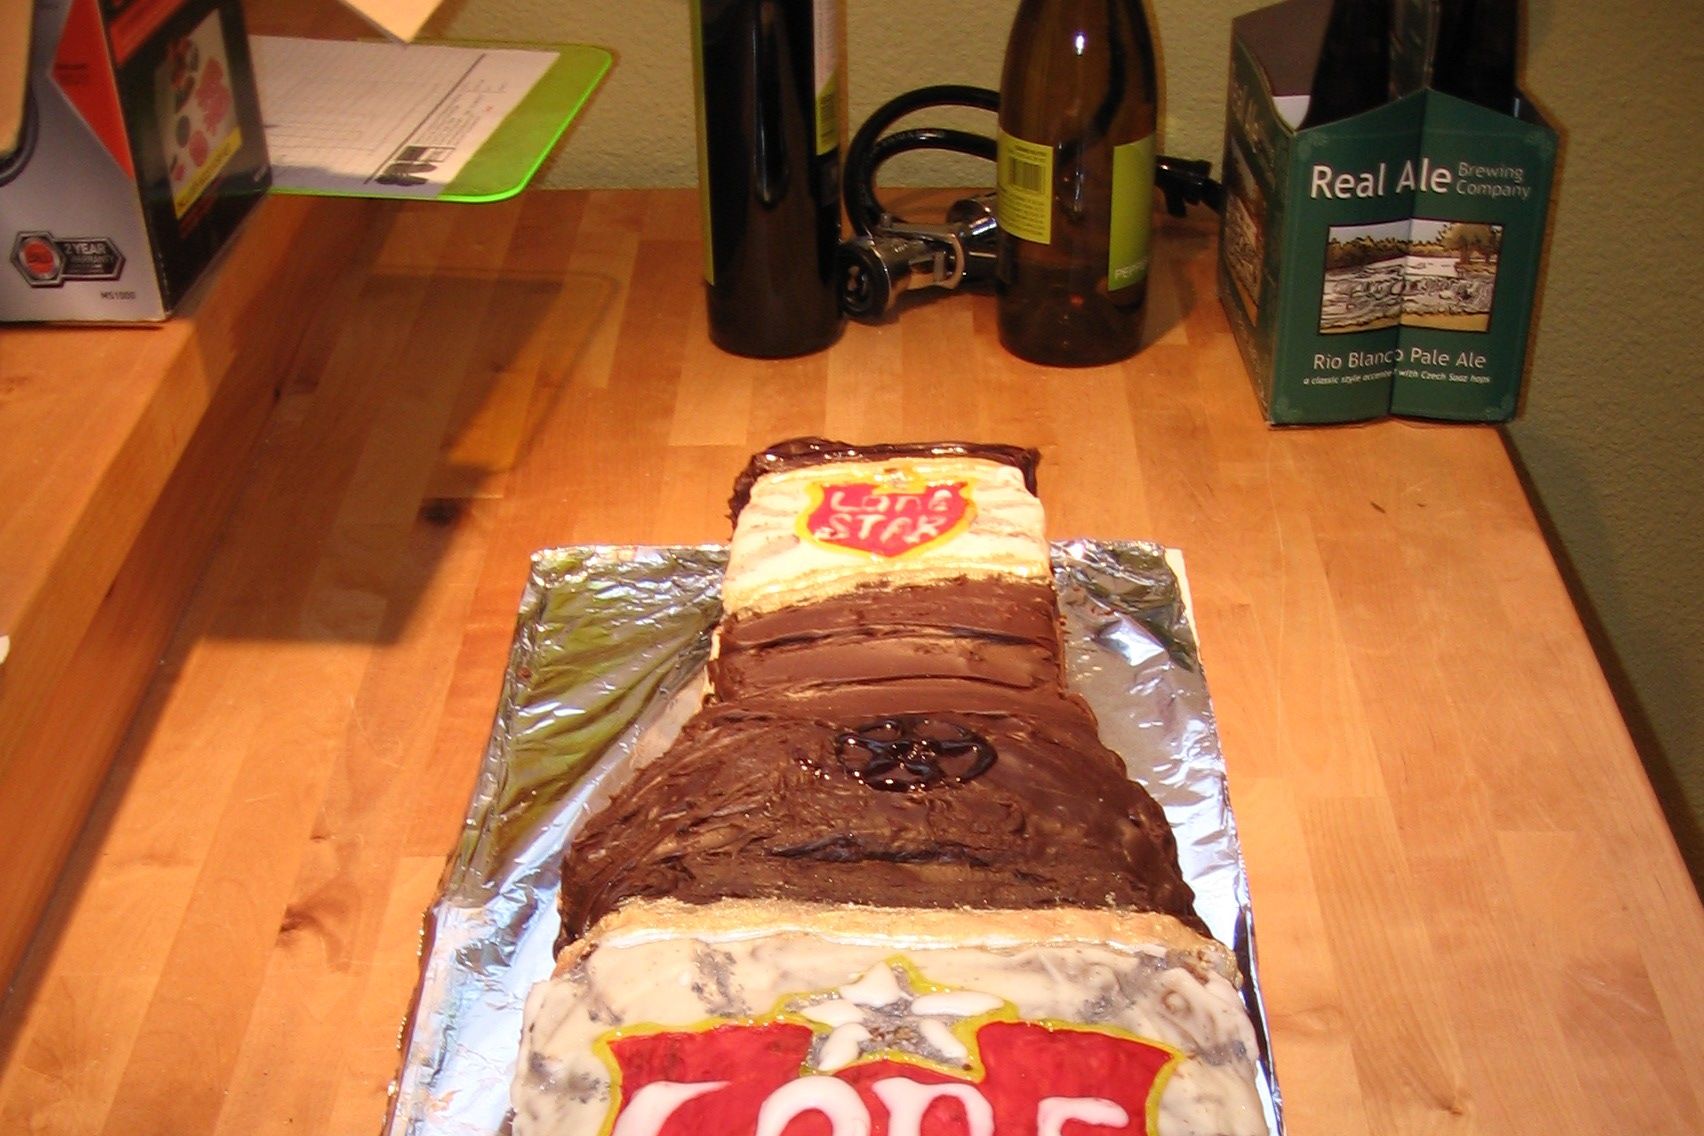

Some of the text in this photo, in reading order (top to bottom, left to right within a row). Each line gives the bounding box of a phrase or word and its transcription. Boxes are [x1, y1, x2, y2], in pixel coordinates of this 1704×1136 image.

[1310, 157, 1452, 199] Real Ale
[1457, 161, 1524, 183] Brewing
[1455, 178, 1531, 200] Company
[72, 242, 106, 255] YEAR
[1313, 347, 1486, 370] Rio Blanco Pale Ale
[814, 514, 948, 543] STAR
